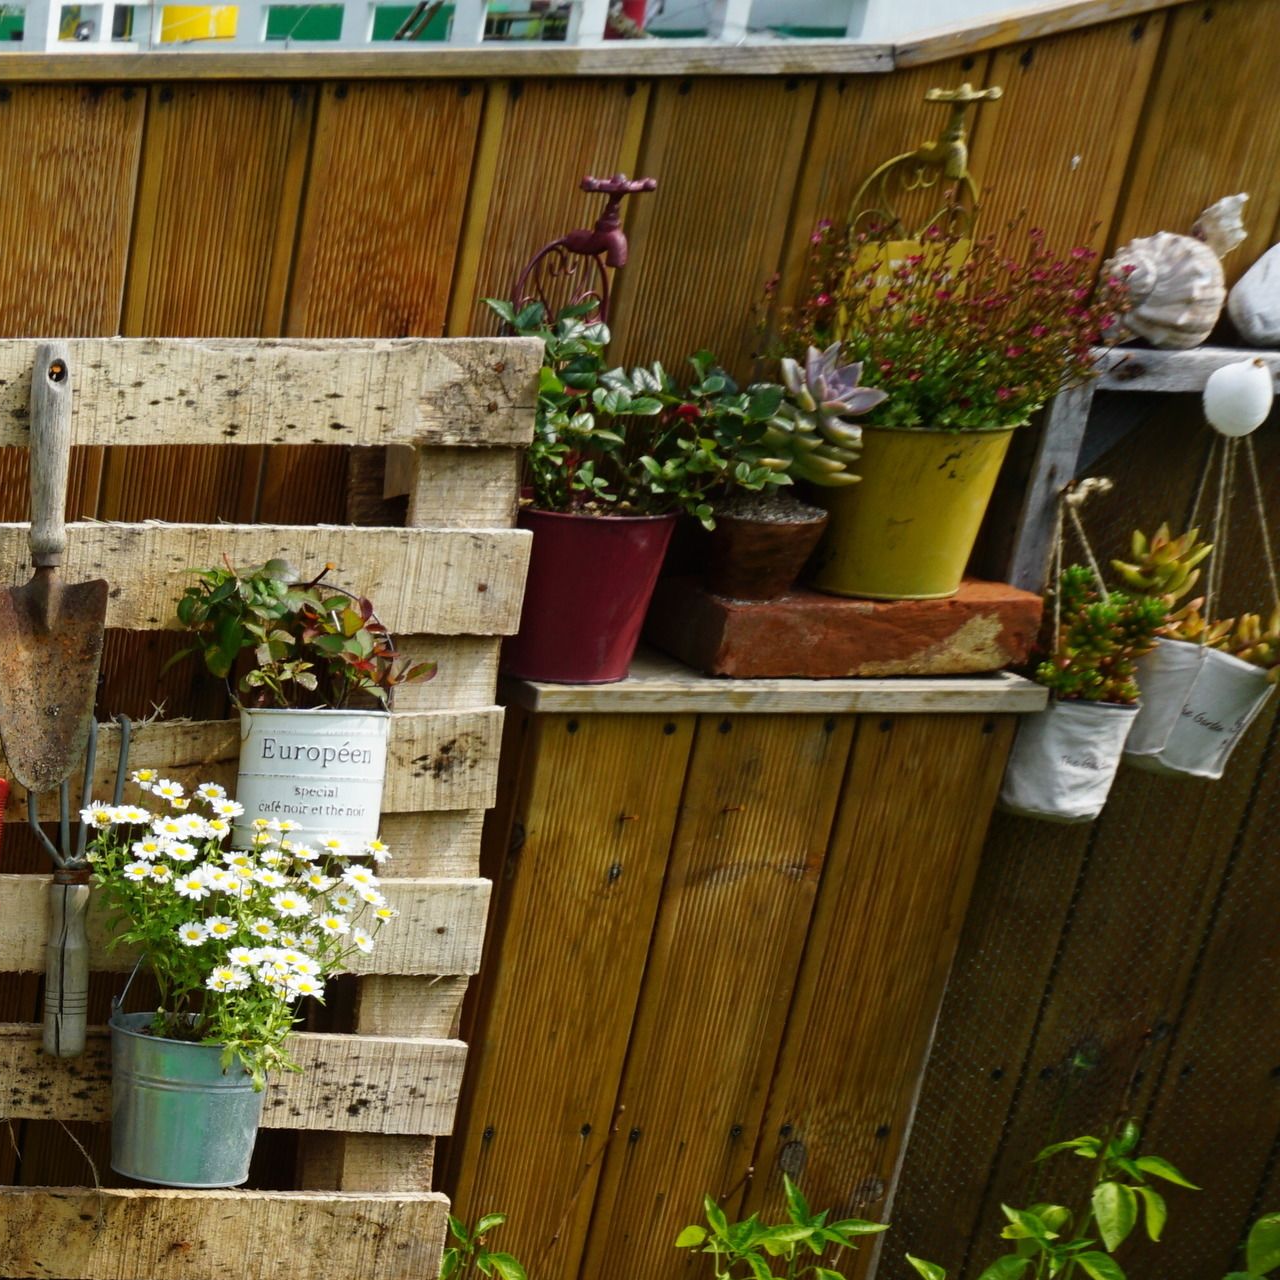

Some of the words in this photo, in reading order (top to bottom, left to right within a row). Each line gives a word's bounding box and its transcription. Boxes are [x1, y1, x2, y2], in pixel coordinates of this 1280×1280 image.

[261, 738, 372, 768] Européen
[294, 785, 339, 800] special
[258, 800, 281, 813] café
[311, 804, 323, 815] et
